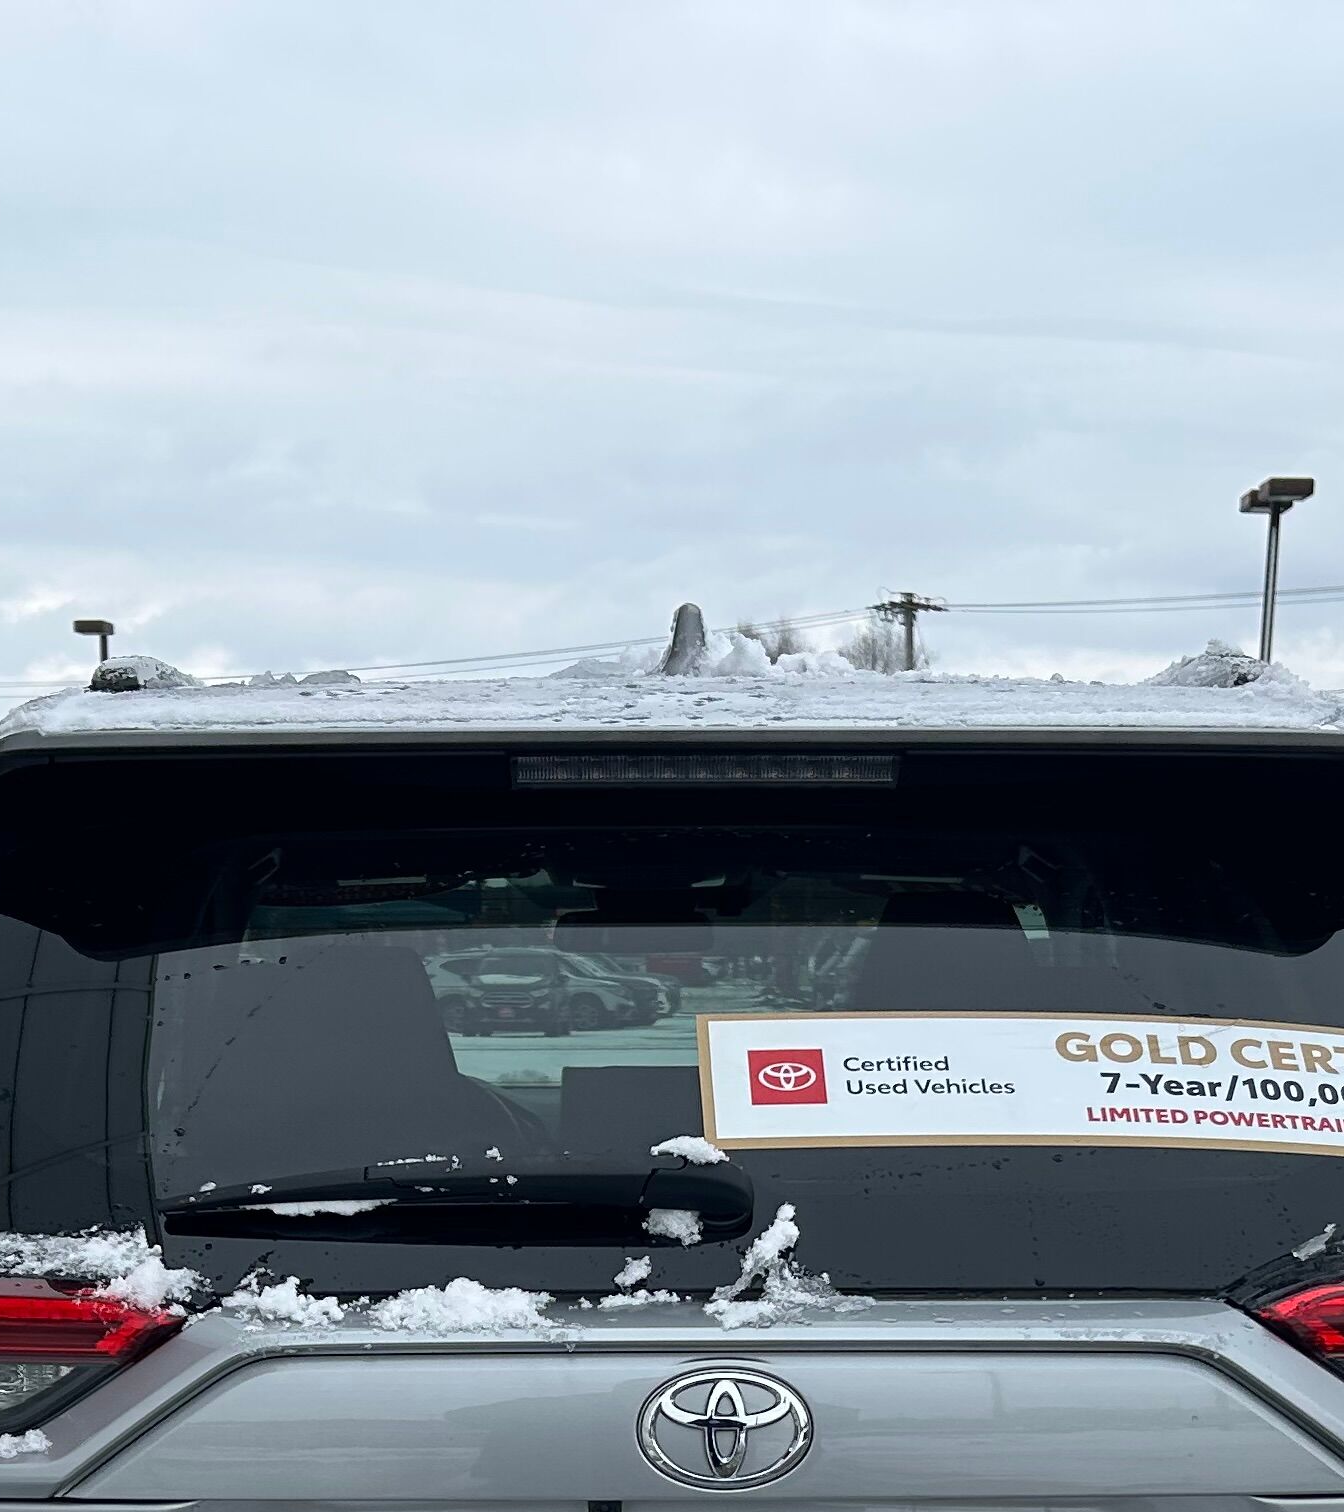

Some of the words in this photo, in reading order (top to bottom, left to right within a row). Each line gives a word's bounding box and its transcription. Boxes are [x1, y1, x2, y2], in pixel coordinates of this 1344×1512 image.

[1055, 1031, 1218, 1067] GOLD
[842, 1055, 950, 1073] Certified
[845, 1078, 908, 1095] Used
[913, 1078, 1017, 1095] Vehicles
[1086, 1106, 1189, 1125] LIMITED
